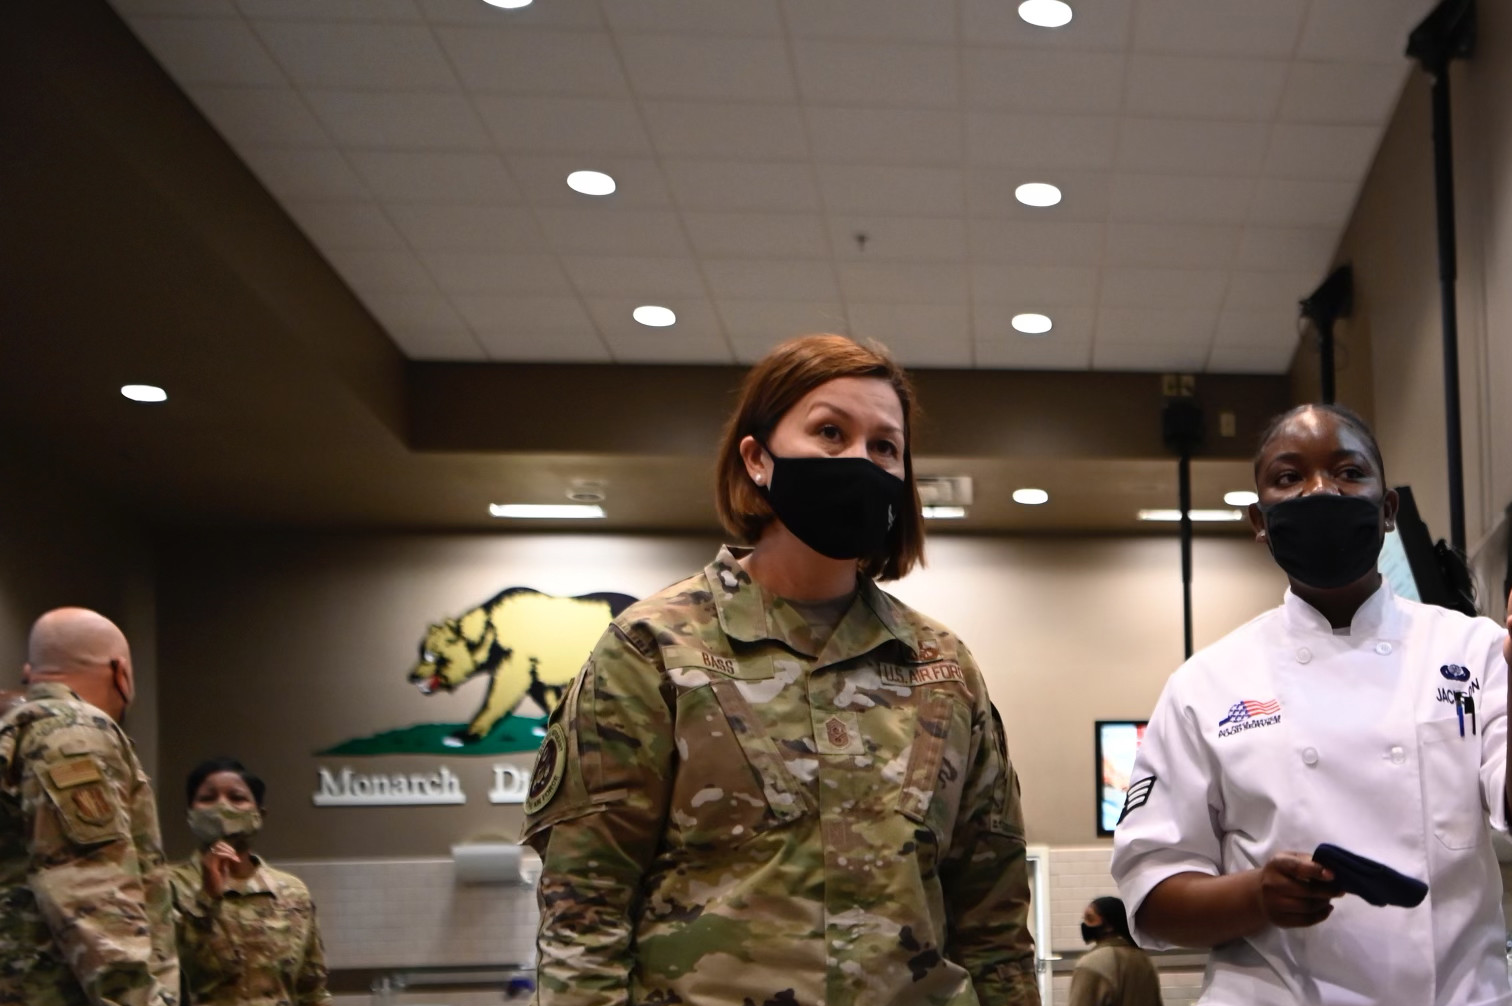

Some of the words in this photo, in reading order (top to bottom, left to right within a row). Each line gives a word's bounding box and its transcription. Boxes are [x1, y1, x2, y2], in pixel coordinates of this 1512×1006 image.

[702, 652, 735, 675] BASS
[884, 665, 908, 684] U.S.
[909, 667, 933, 684] AIR
[932, 664, 960, 680] FOR
[317, 765, 460, 796] Monarch
